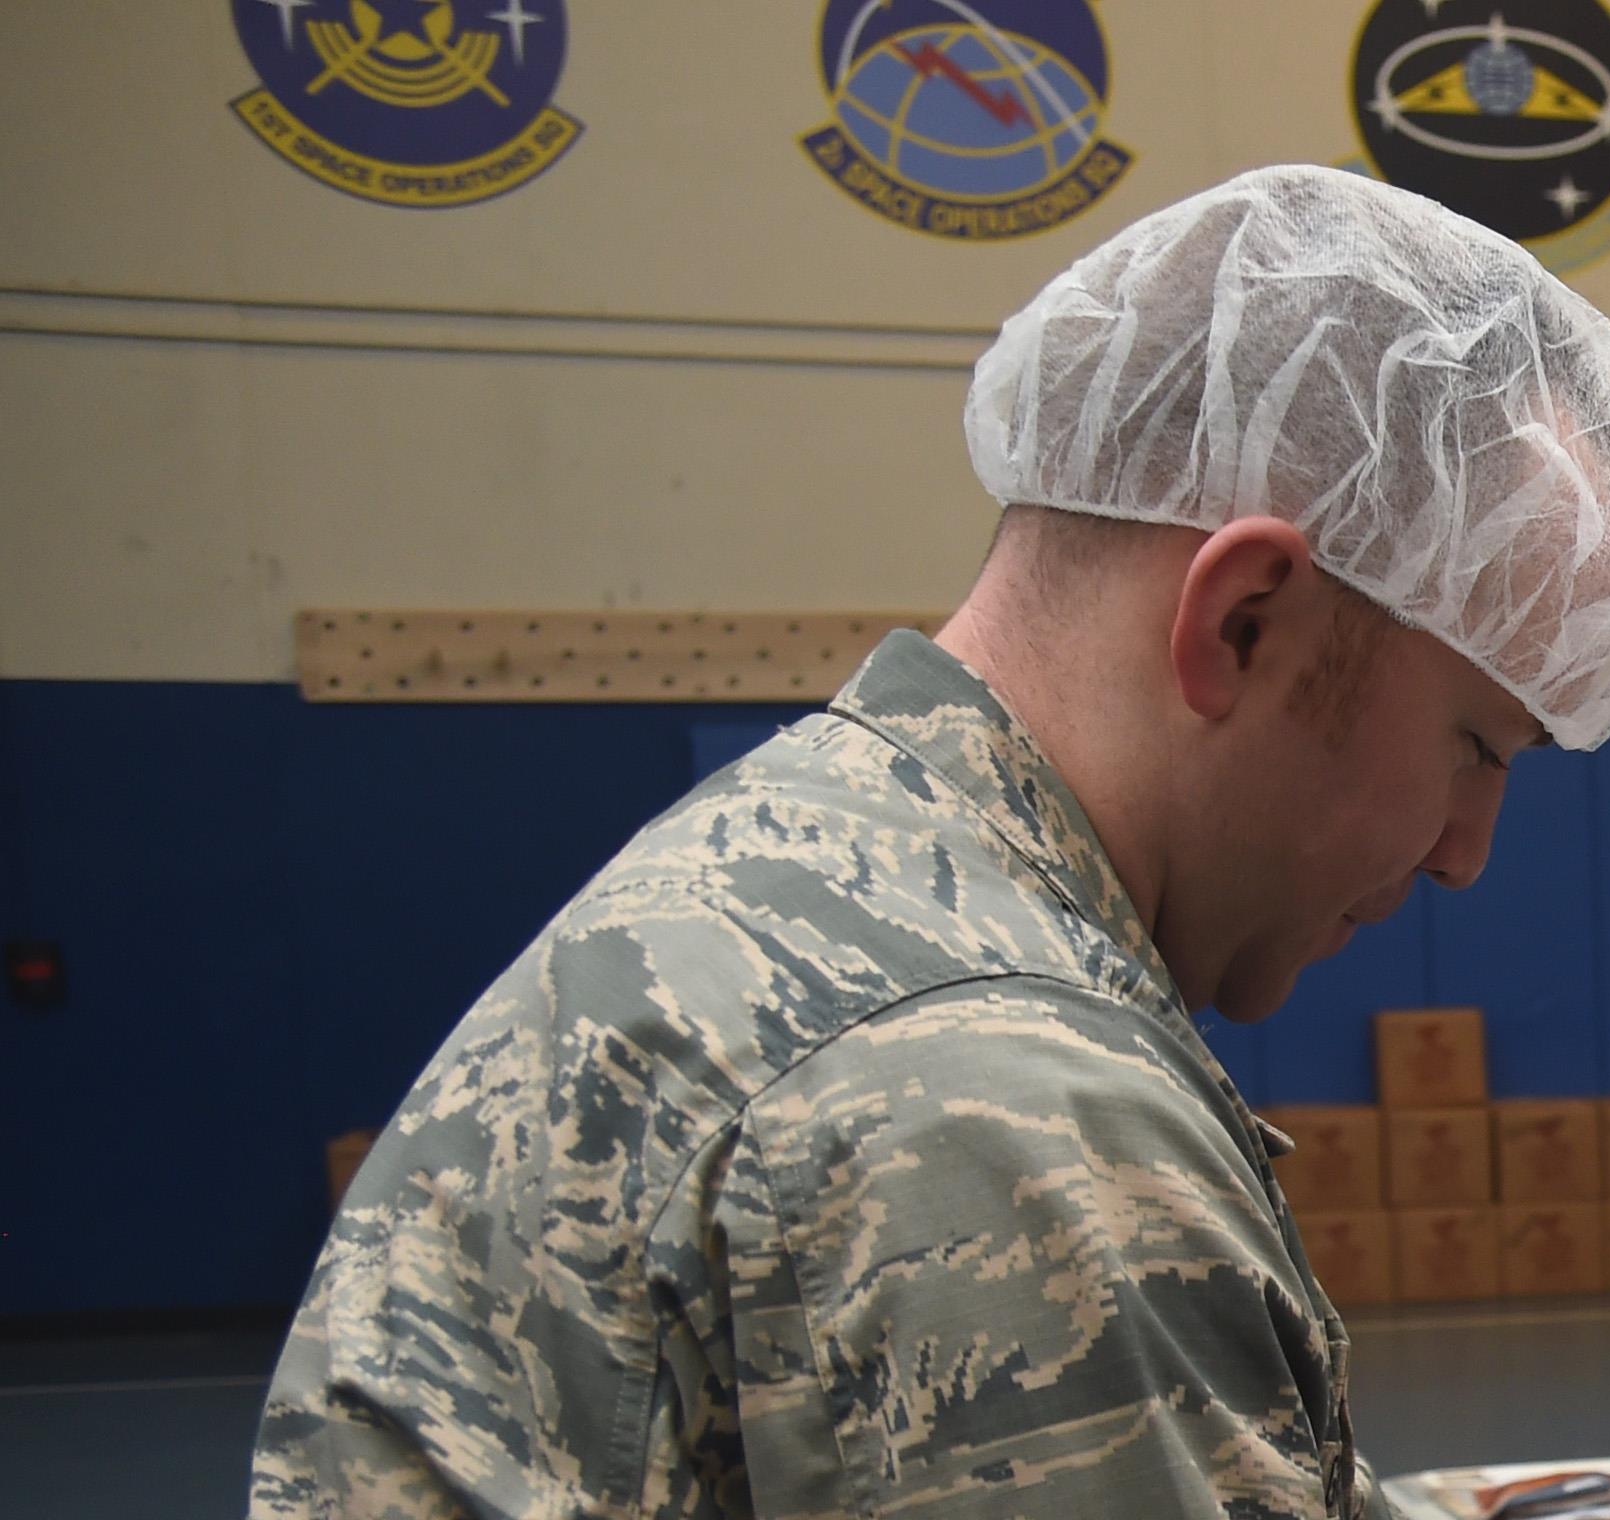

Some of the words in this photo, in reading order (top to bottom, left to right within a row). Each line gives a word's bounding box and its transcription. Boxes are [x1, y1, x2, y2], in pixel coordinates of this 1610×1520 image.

[293, 137, 370, 187] SPACE
[380, 146, 536, 194] OPERATIONS
[843, 162, 923, 230] SPACE
[930, 181, 1091, 239] OPERATIONS
